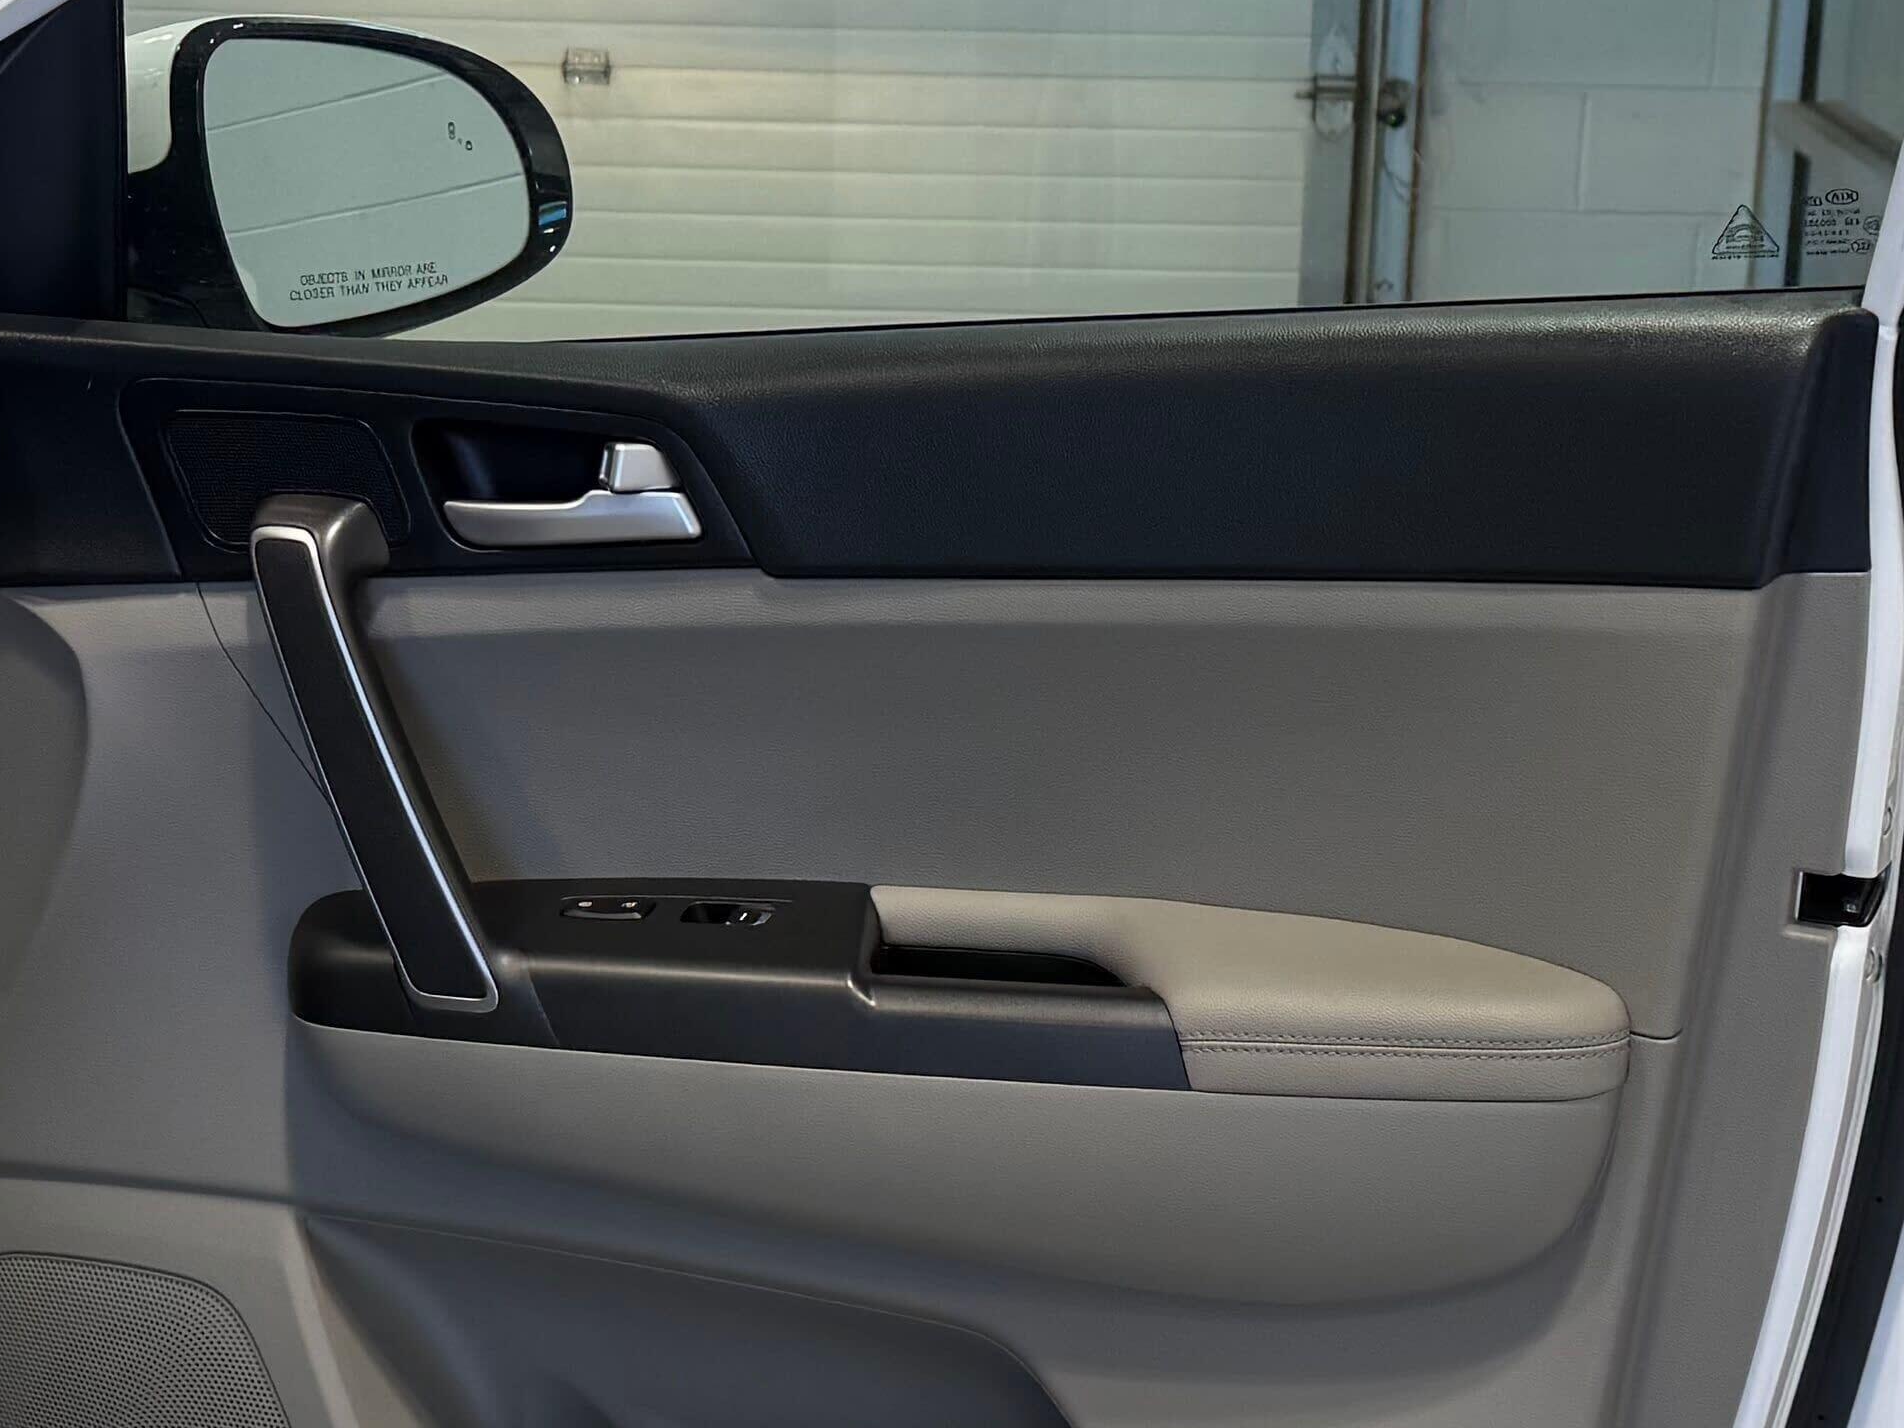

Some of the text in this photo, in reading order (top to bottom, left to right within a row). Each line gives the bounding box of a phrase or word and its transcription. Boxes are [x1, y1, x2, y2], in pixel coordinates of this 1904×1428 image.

[300, 262, 437, 286] OBJECTS IN MIRROR ARE
[289, 274, 448, 301] CLOSER THAN THEY APPEAR
